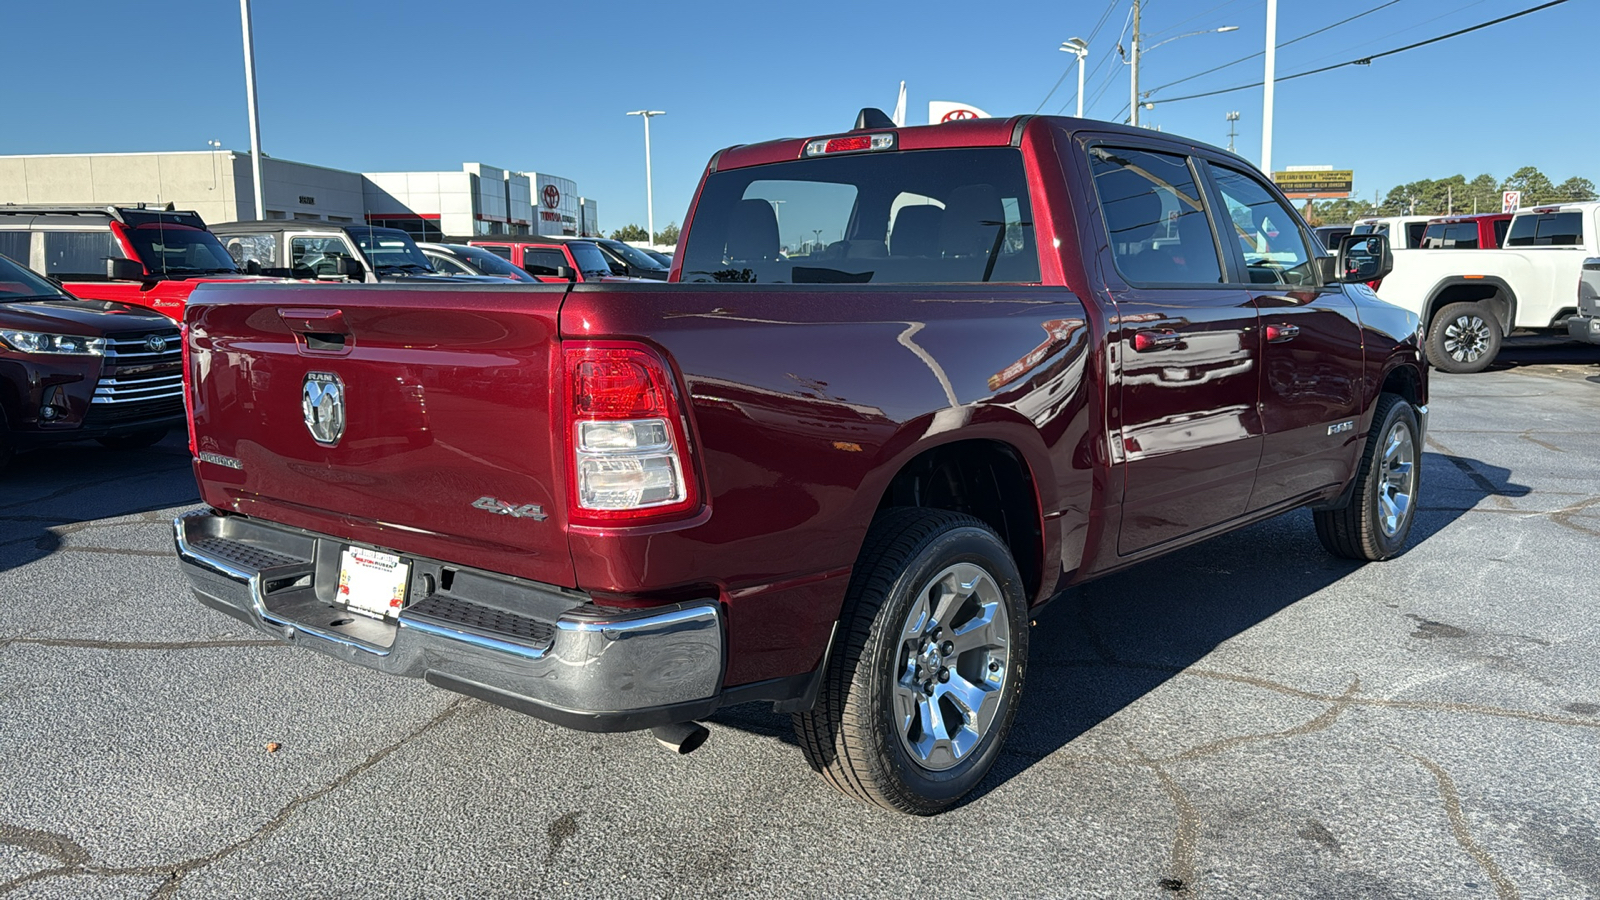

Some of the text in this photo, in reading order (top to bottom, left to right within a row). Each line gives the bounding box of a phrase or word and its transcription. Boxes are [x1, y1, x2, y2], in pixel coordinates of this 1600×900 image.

[540, 212, 562, 222] TOYOTA
[152, 298, 180, 307] Bronco
[307, 373, 334, 381] RAM
